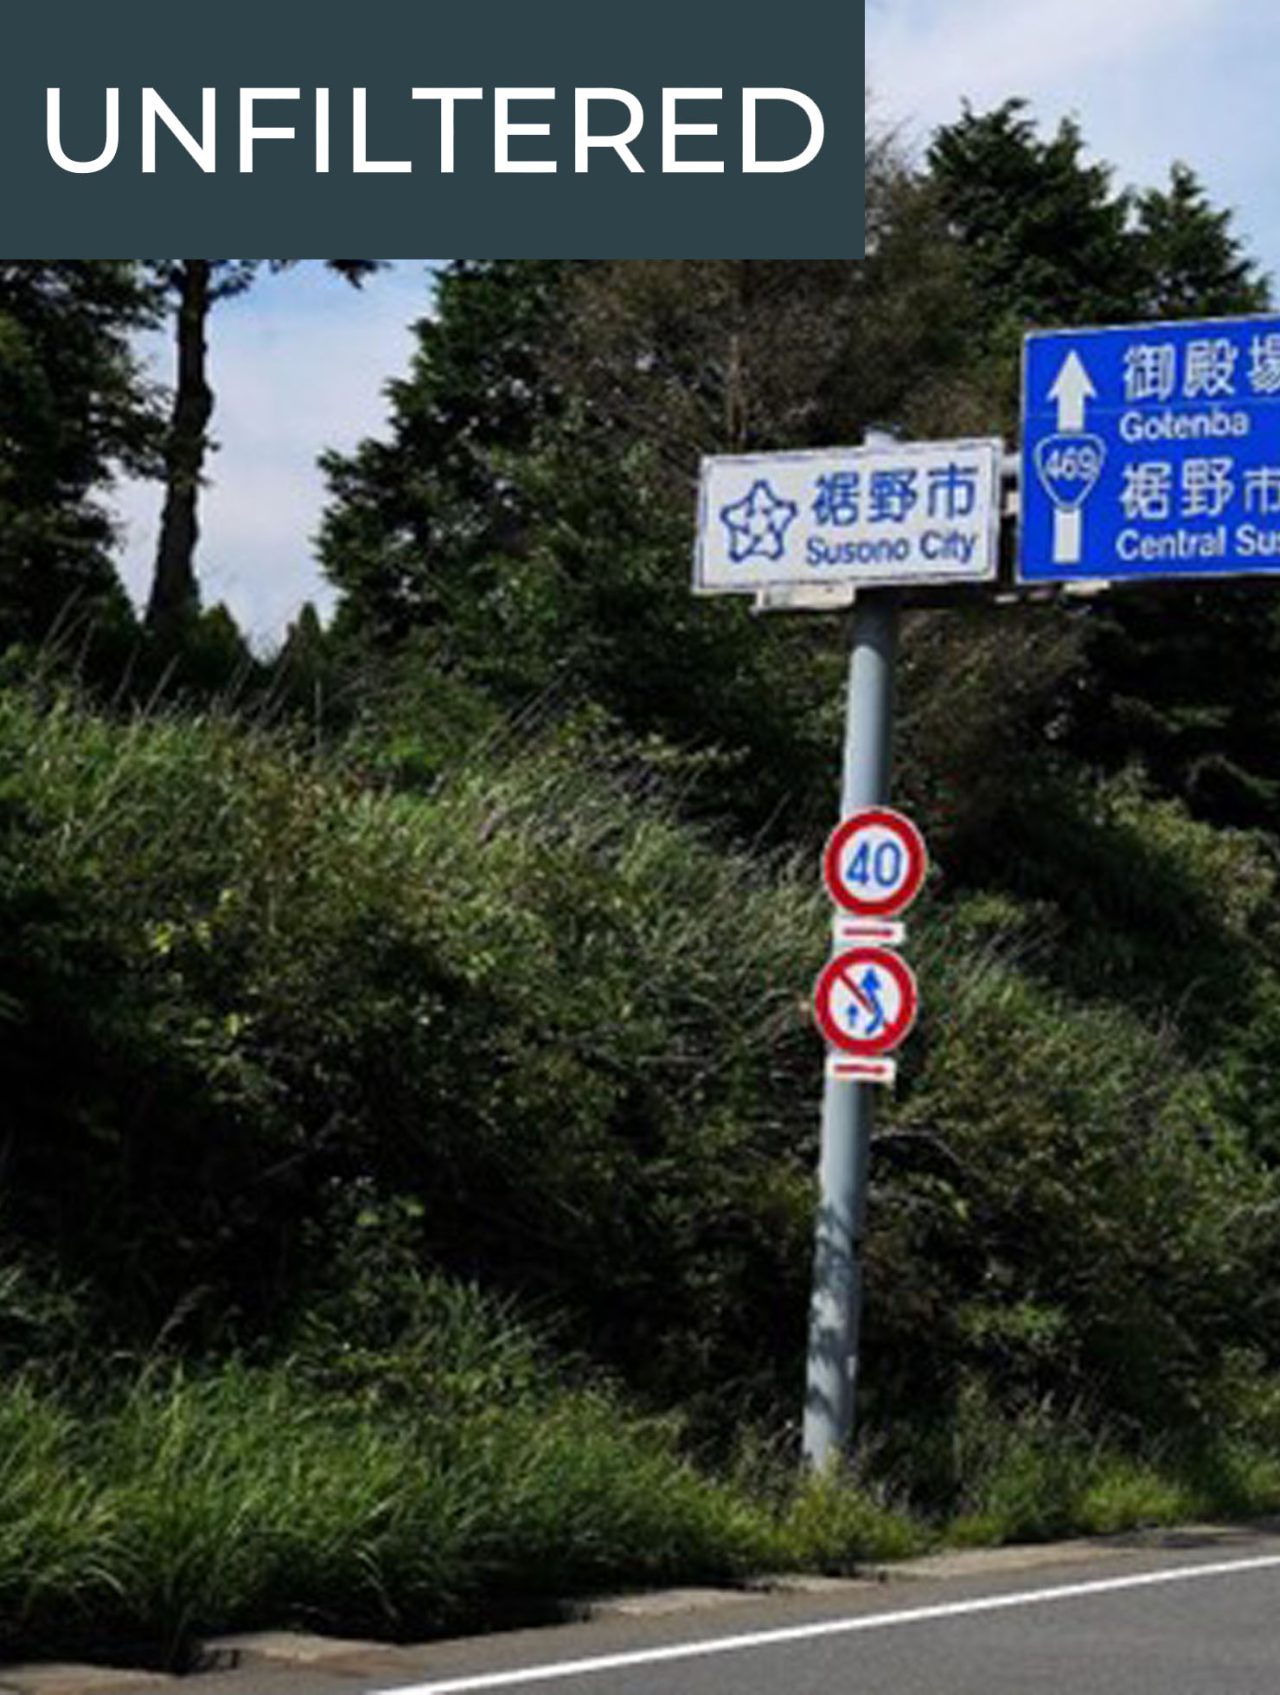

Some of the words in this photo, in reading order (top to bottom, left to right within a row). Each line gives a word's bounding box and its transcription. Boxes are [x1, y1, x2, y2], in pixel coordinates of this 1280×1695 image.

[1119, 406, 1250, 443] Gotenba
[1045, 445, 1098, 483] 469
[811, 462, 978, 526] 裾野市
[805, 537, 909, 566] Susono
[919, 530, 976, 564] City
[1115, 529, 1226, 562] Central
[845, 840, 901, 887] 40
